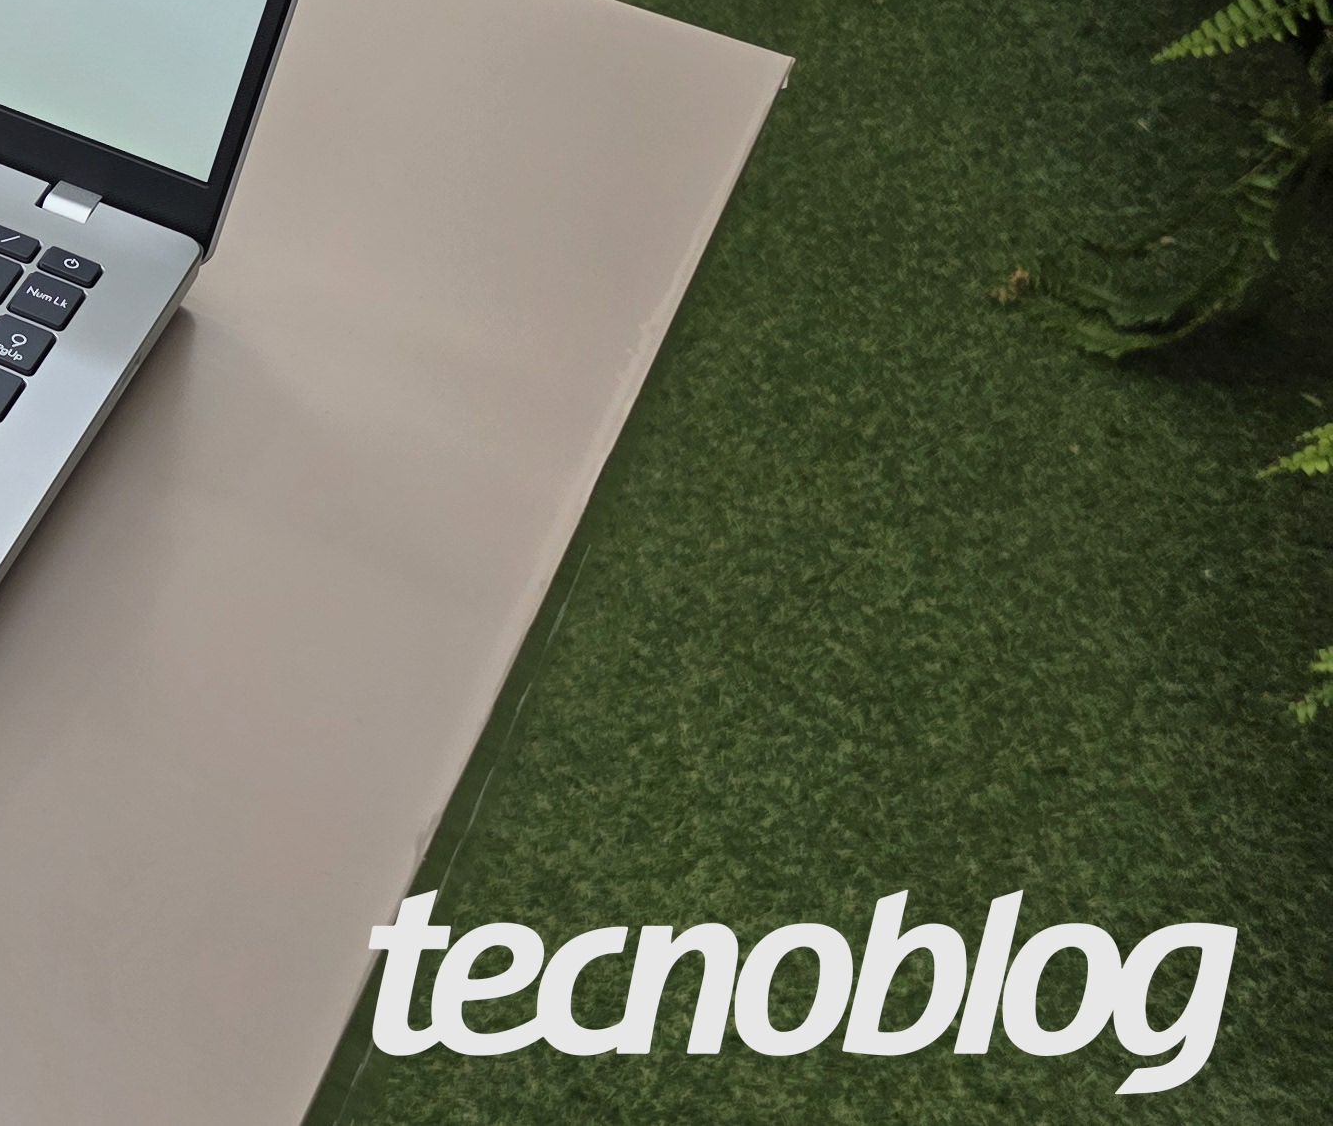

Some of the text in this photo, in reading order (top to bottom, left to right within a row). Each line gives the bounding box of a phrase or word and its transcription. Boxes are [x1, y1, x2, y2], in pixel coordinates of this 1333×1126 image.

[26, 286, 67, 308] Num Lk
[12, 334, 27, 347] 9
